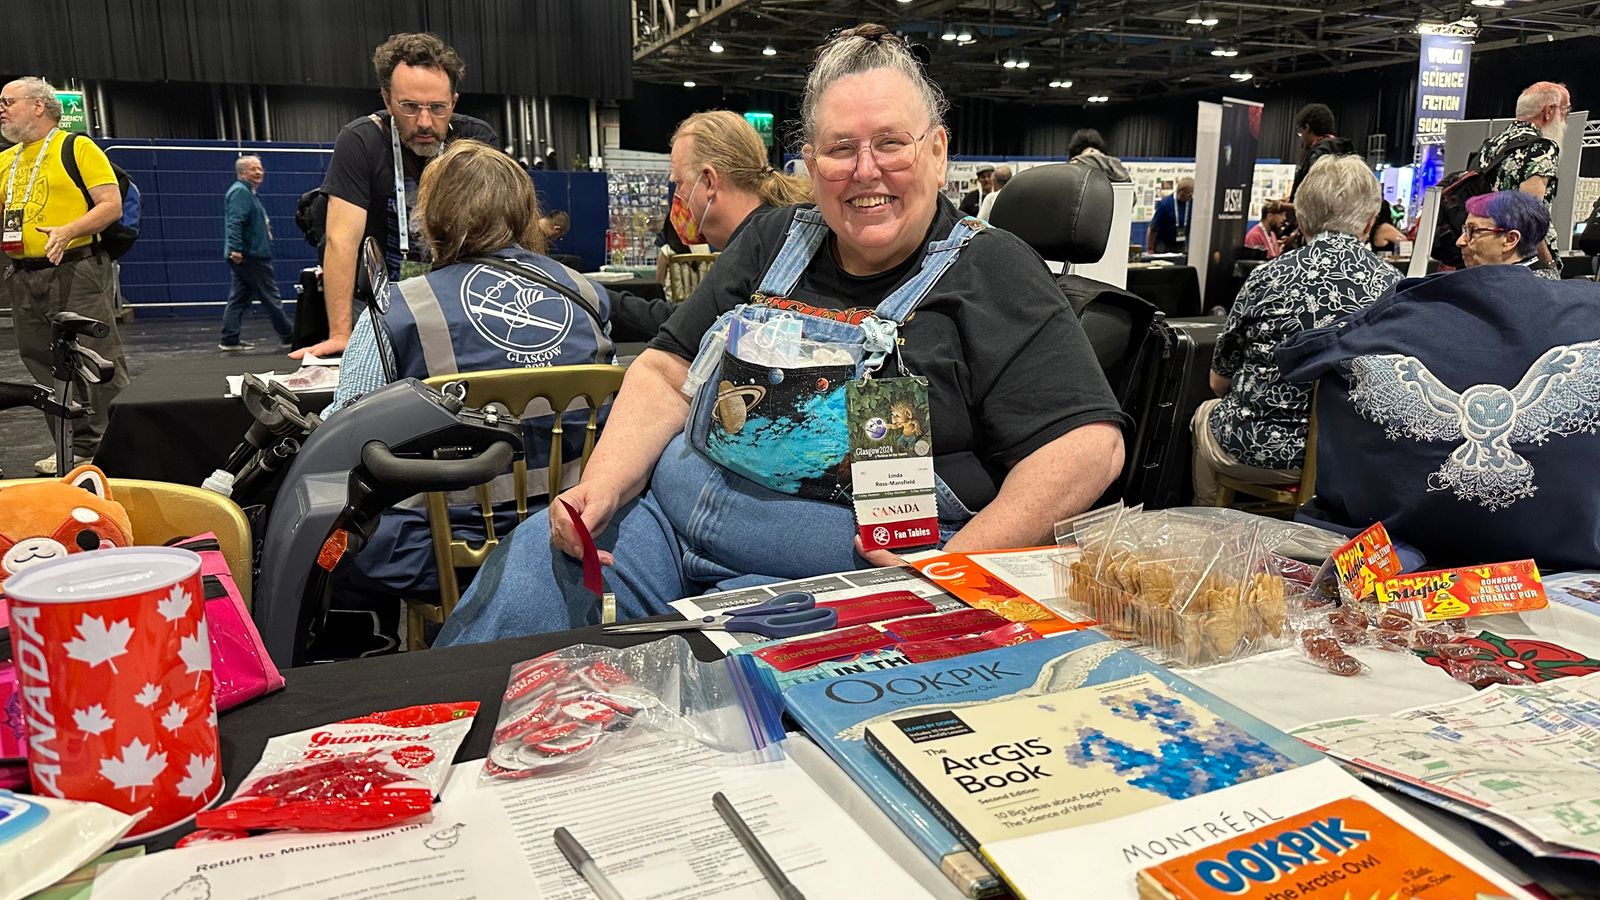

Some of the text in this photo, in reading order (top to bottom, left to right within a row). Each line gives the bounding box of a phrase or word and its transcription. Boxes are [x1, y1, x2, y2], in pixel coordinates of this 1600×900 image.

[1428, 47, 1464, 64] WORLD
[1422, 71, 1465, 88] SCIENCE
[1422, 94, 1460, 111] FICTION
[1418, 117, 1459, 133] SOCIE
[506, 346, 562, 364] GLASGOW
[875, 479, 916, 487] Ross-Mansfield
[872, 503, 920, 517] CANADA
[894, 528, 930, 539] Fan Tables
[1480, 584, 1523, 594] AU SIROP
[1481, 576, 1518, 585] BONBONS
[1387, 580, 1450, 602] Maple
[1470, 590, 1538, 604] D'ÉRABLE PUR
[774, 643, 836, 663] Montreal
[850, 632, 885, 645] 2027
[1004, 633, 1034, 647] 027
[833, 656, 909, 676] IN TH
[507, 671, 549, 699] CANADA
[11, 606, 65, 799] ANADA
[909, 694, 936, 706] Travels
[938, 692, 944, 700] of
[950, 688, 978, 698] Snowy
[978, 684, 998, 692] Owl
[904, 724, 926, 732] LEARN
[935, 718, 958, 727] DOING
[308, 732, 431, 748] Gummies
[922, 748, 948, 757] The
[942, 738, 1052, 775] ArcGIS
[954, 762, 1053, 794] Book
[978, 787, 1040, 804] Second Edition
[994, 786, 1121, 820] 10 Big Ideas about Applying
[1002, 818, 1024, 829] The
[1024, 810, 1060, 824] Science
[1060, 806, 1070, 816] of
[1122, 806, 1284, 864] MONTRÉAL
[196, 822, 424, 872] Return to Montréal! Join us!
[1195, 817, 1370, 894] OOKPIK
[1264, 854, 1381, 900] the Arctic Owl
